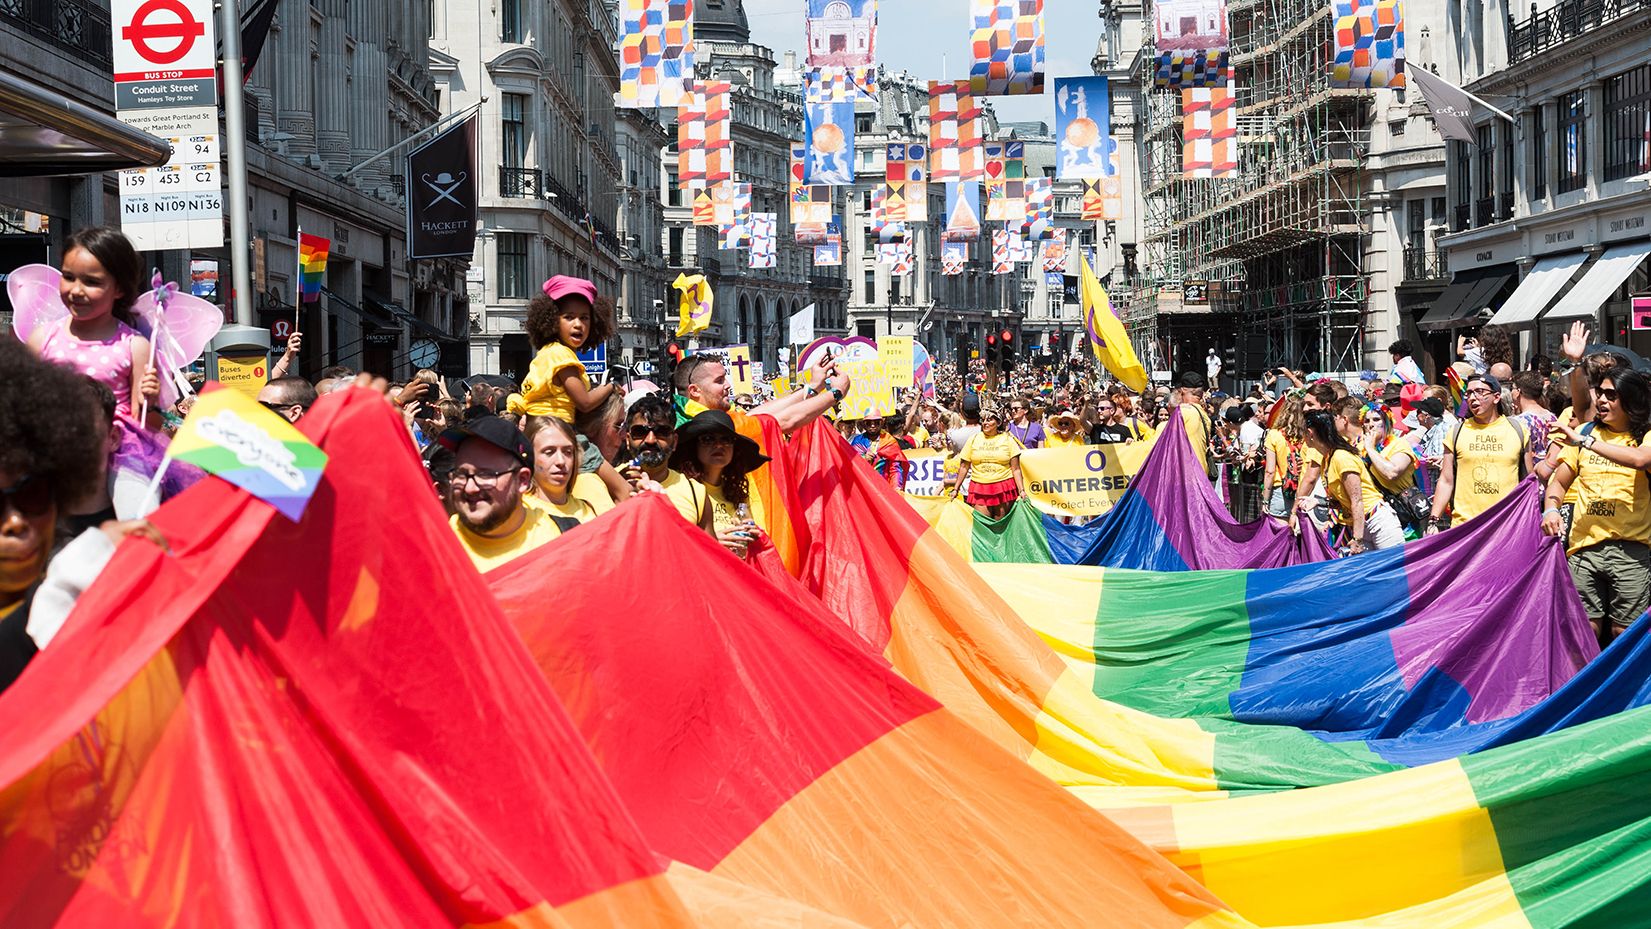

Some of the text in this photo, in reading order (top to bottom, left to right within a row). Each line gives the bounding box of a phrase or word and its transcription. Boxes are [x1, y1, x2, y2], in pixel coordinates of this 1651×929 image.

[132, 84, 199, 95] Conduit Street
[1436, 105, 1470, 117] COACH
[125, 116, 151, 124] towards
[195, 144, 209, 154] 94
[126, 172, 211, 186] 159 453 C2
[126, 199, 220, 214] N18 N109 N136
[421, 220, 468, 231] HACKETT
[1475, 434, 1497, 443] FLAG
[1469, 443, 1504, 451] BEARER
[908, 460, 944, 482] RSE
[1051, 500, 1085, 509] Protect
[1587, 508, 1615, 517] LONDON
